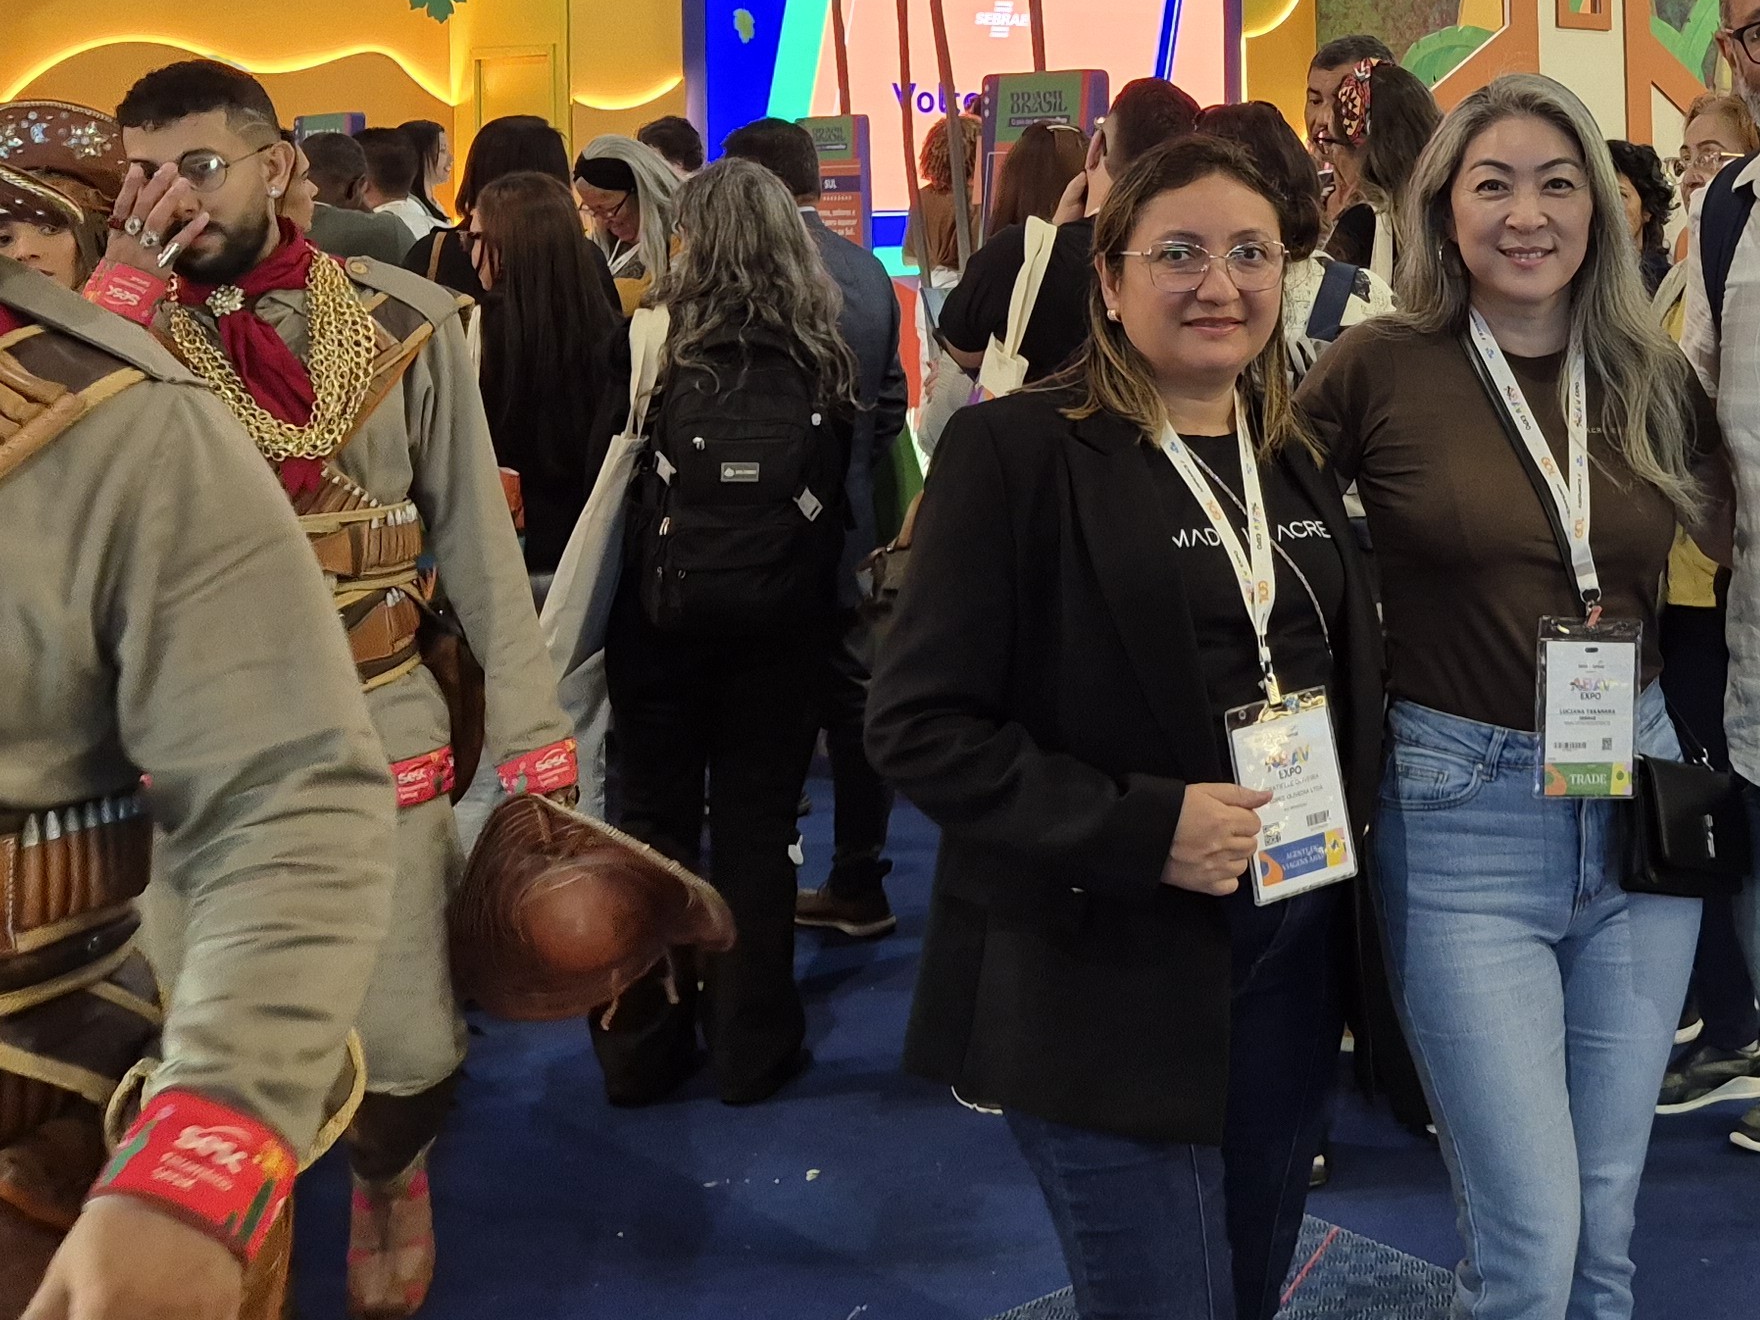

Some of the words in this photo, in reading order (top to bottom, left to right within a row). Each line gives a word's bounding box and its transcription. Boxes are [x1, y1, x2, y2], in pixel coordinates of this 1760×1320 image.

[975, 12, 1029, 27] SEBRAE
[1010, 91, 1068, 115] BRASIL
[1277, 520, 1332, 542] ACRE
[1580, 692, 1602, 701] EXPO
[1570, 773, 1608, 785] TRADE
